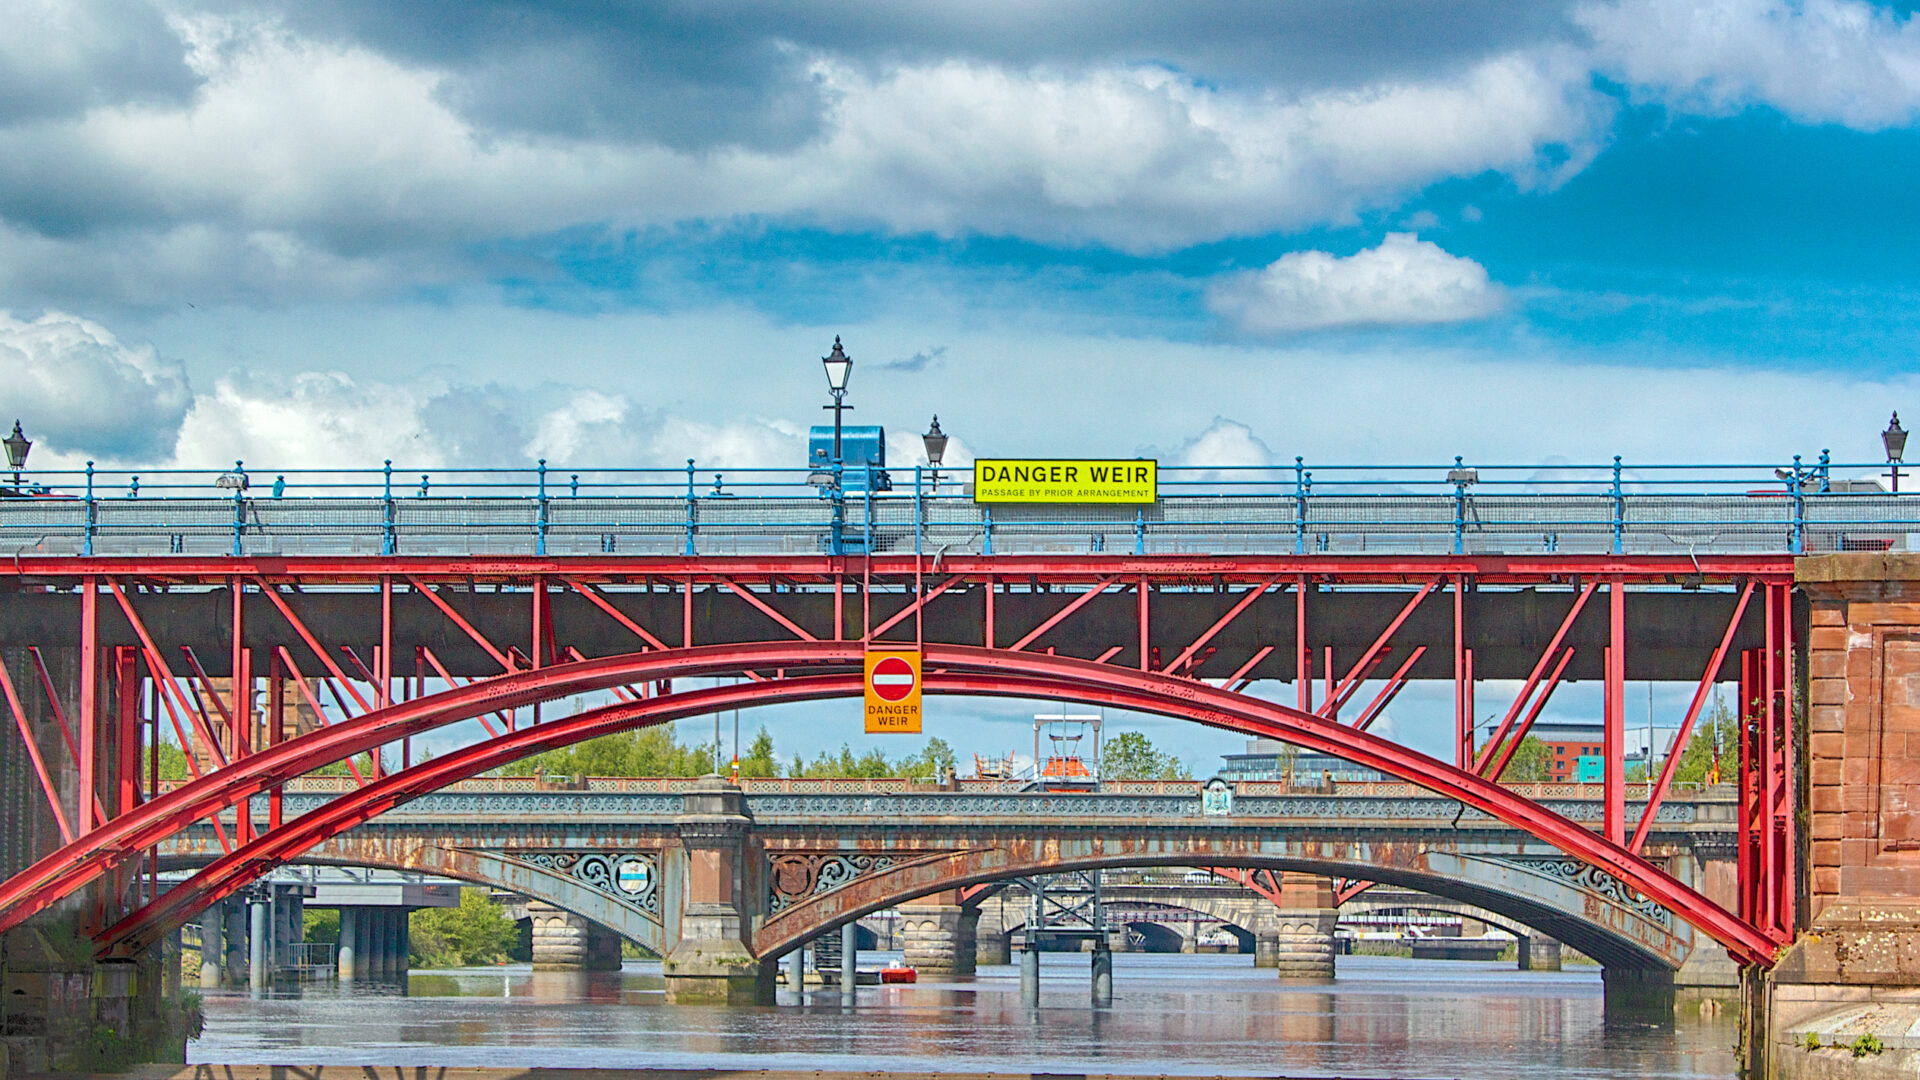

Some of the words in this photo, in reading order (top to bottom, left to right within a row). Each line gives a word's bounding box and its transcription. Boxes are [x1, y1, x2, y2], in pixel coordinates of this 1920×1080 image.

[982, 466, 1078, 482] DANGER
[1090, 467, 1148, 482] WEIR
[1044, 489, 1073, 497] PRIOR
[1076, 489, 1149, 498] ARRANGEMENT
[868, 705, 918, 714] DANGER
[878, 716, 908, 725] WEIR
